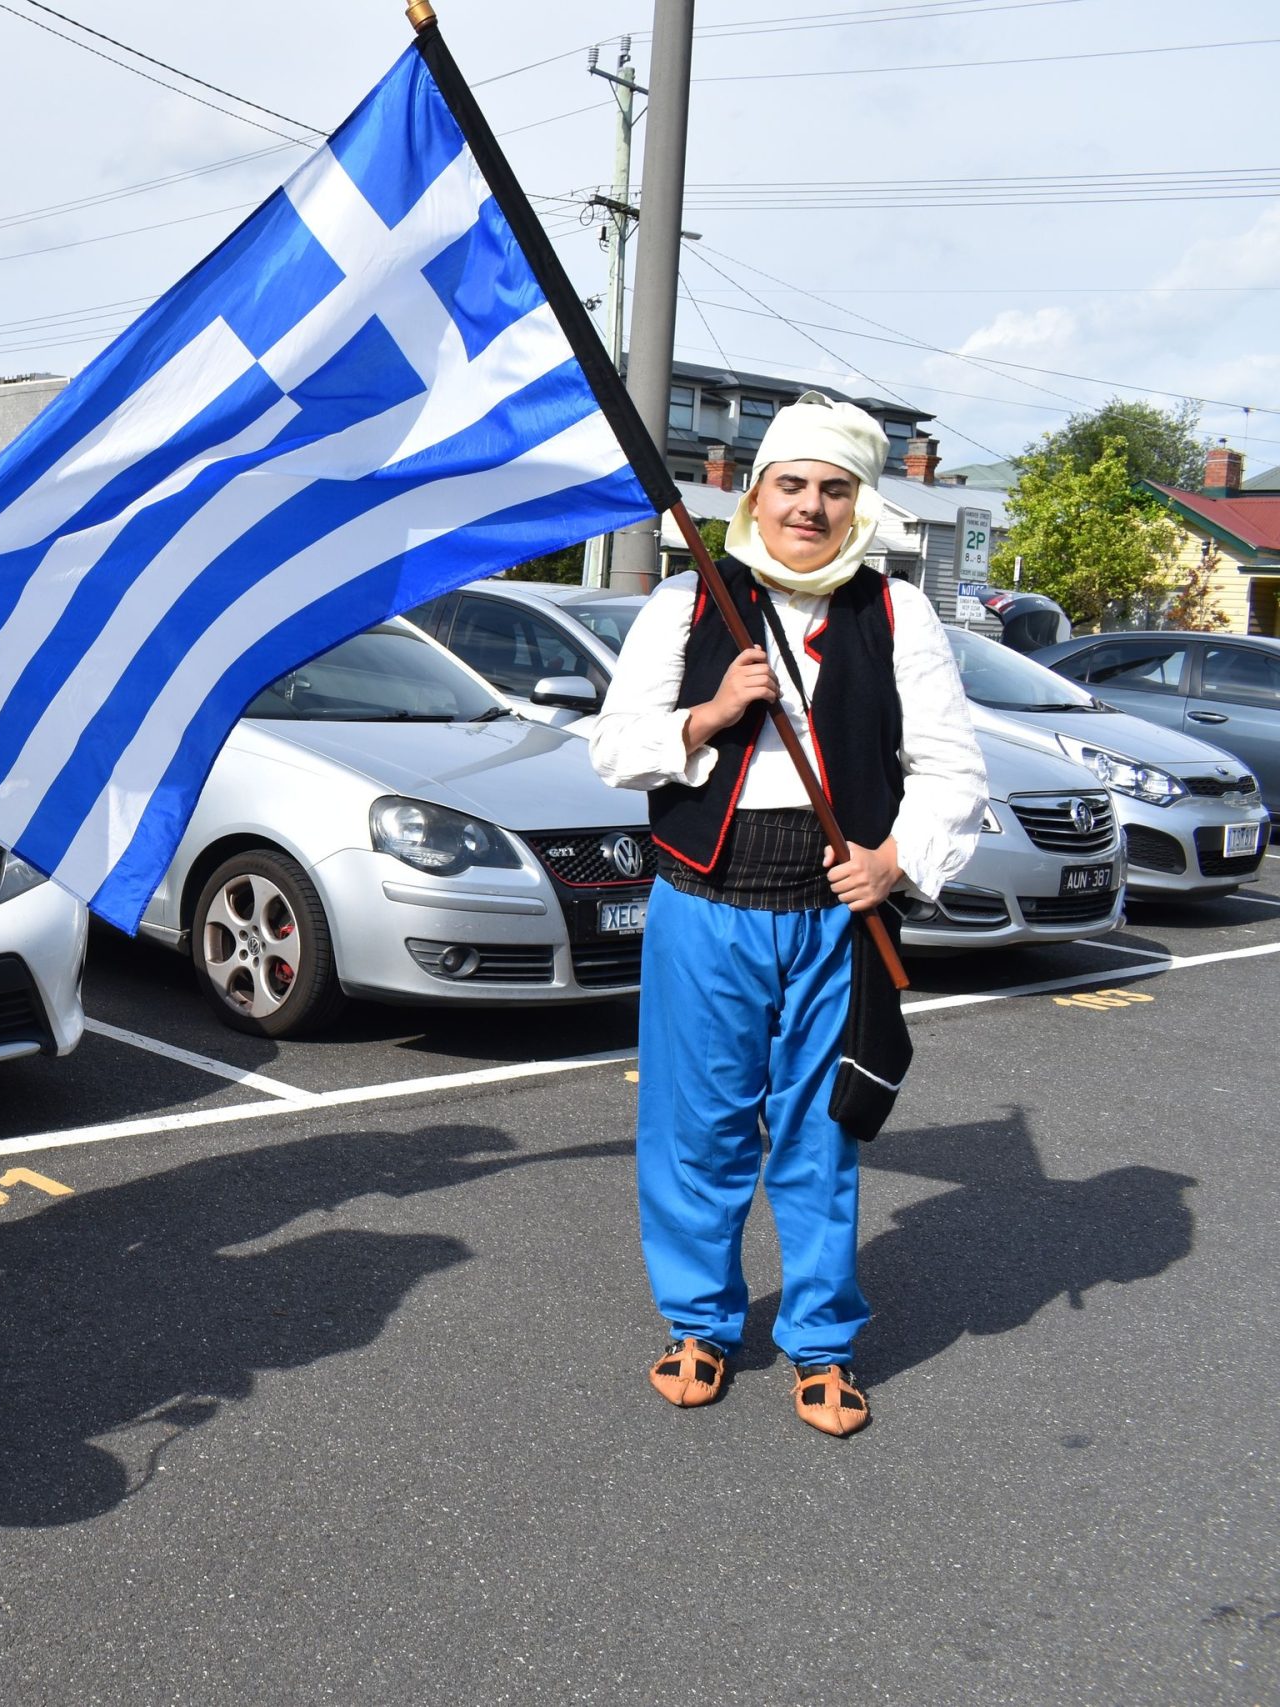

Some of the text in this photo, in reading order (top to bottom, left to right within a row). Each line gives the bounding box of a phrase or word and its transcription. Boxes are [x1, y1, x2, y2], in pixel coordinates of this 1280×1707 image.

[967, 530, 985, 550] 2P
[548, 847, 576, 857] GTI
[1052, 989, 1154, 1011] 163
